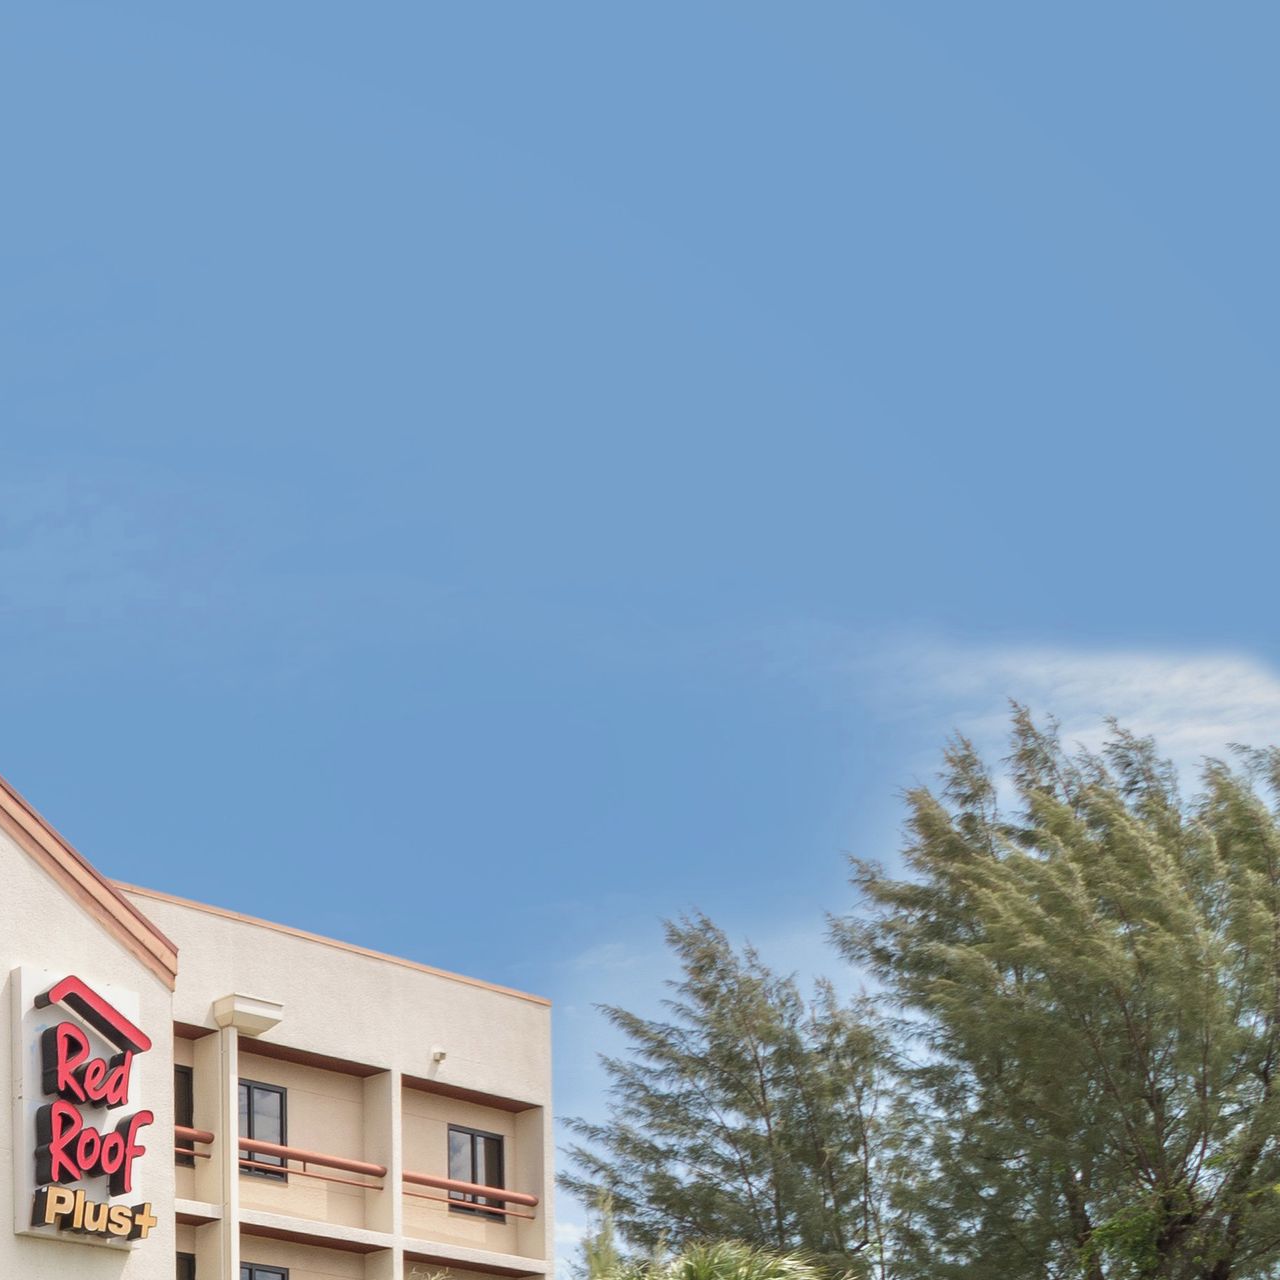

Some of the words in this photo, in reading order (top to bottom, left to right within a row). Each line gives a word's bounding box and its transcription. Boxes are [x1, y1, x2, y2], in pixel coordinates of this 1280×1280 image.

[54, 1021, 134, 1102] Red
[48, 1099, 154, 1193] Roof
[44, 1185, 158, 1239] Plus+
